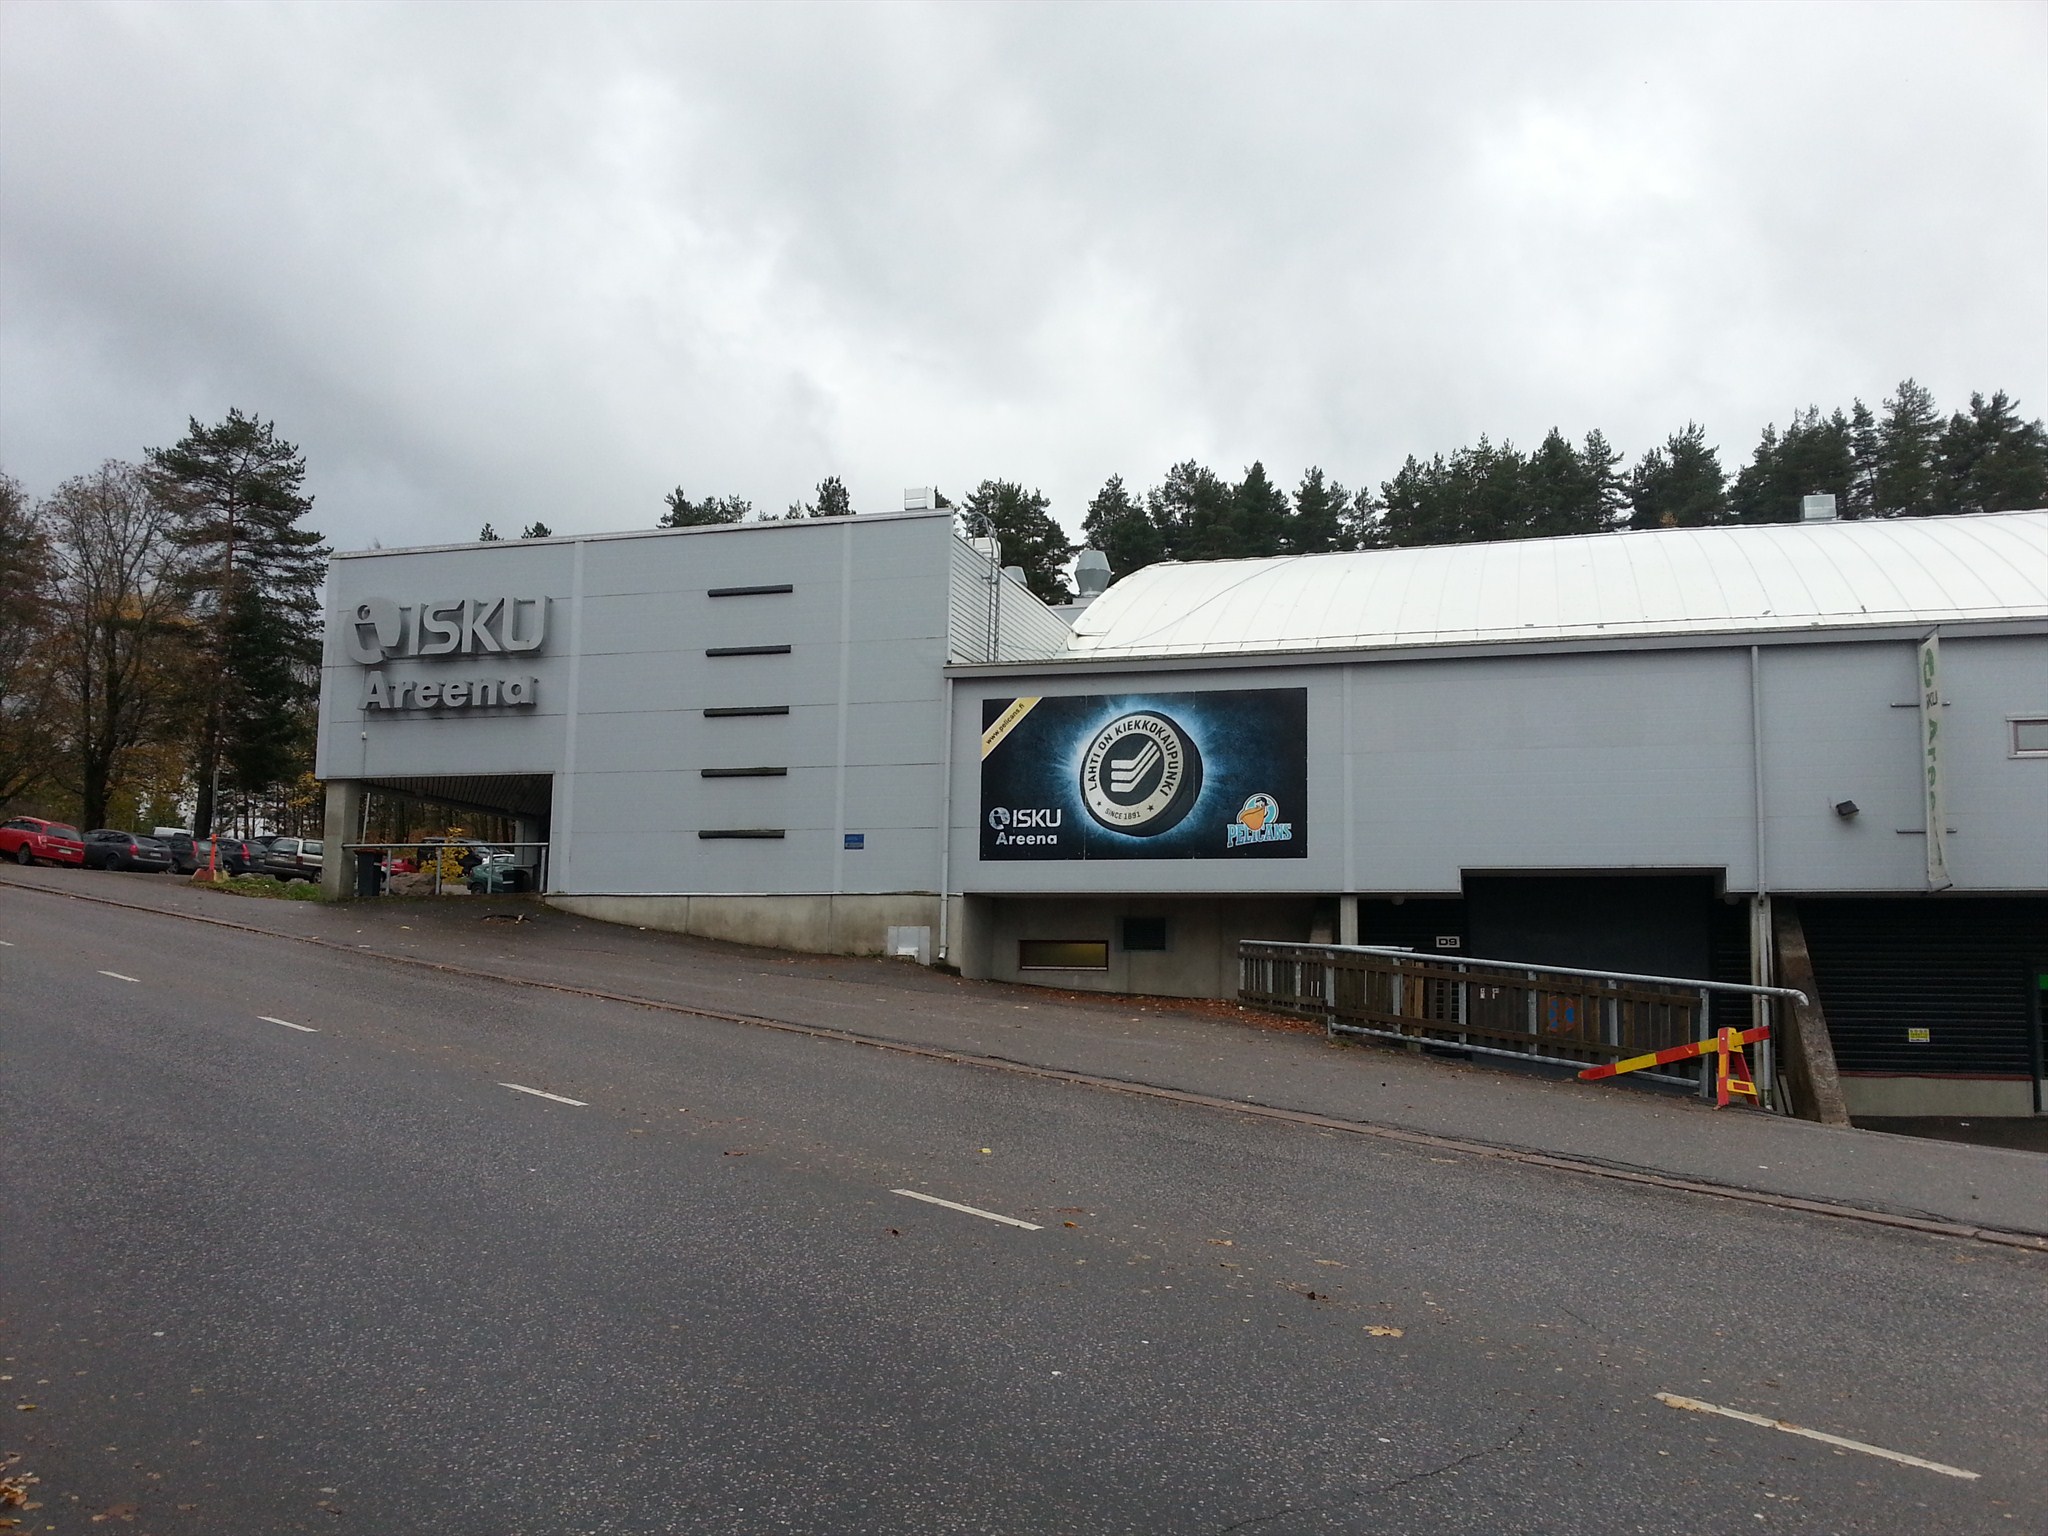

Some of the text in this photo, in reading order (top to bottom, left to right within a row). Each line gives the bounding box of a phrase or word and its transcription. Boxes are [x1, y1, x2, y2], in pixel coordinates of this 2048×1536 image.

[409, 597, 549, 656] ISKU
[363, 670, 536, 709] Areena
[986, 703, 1025, 745] www.pelicans.fi
[1088, 719, 1179, 797] LAHTI ON KIEKKOKAUPUNKI
[1013, 809, 1062, 827] ISKU
[1104, 808, 1141, 820] SINCE 1891
[995, 831, 1058, 845] Areena
[1226, 823, 1292, 848] PELICANS
[1438, 938, 1457, 946] D9
